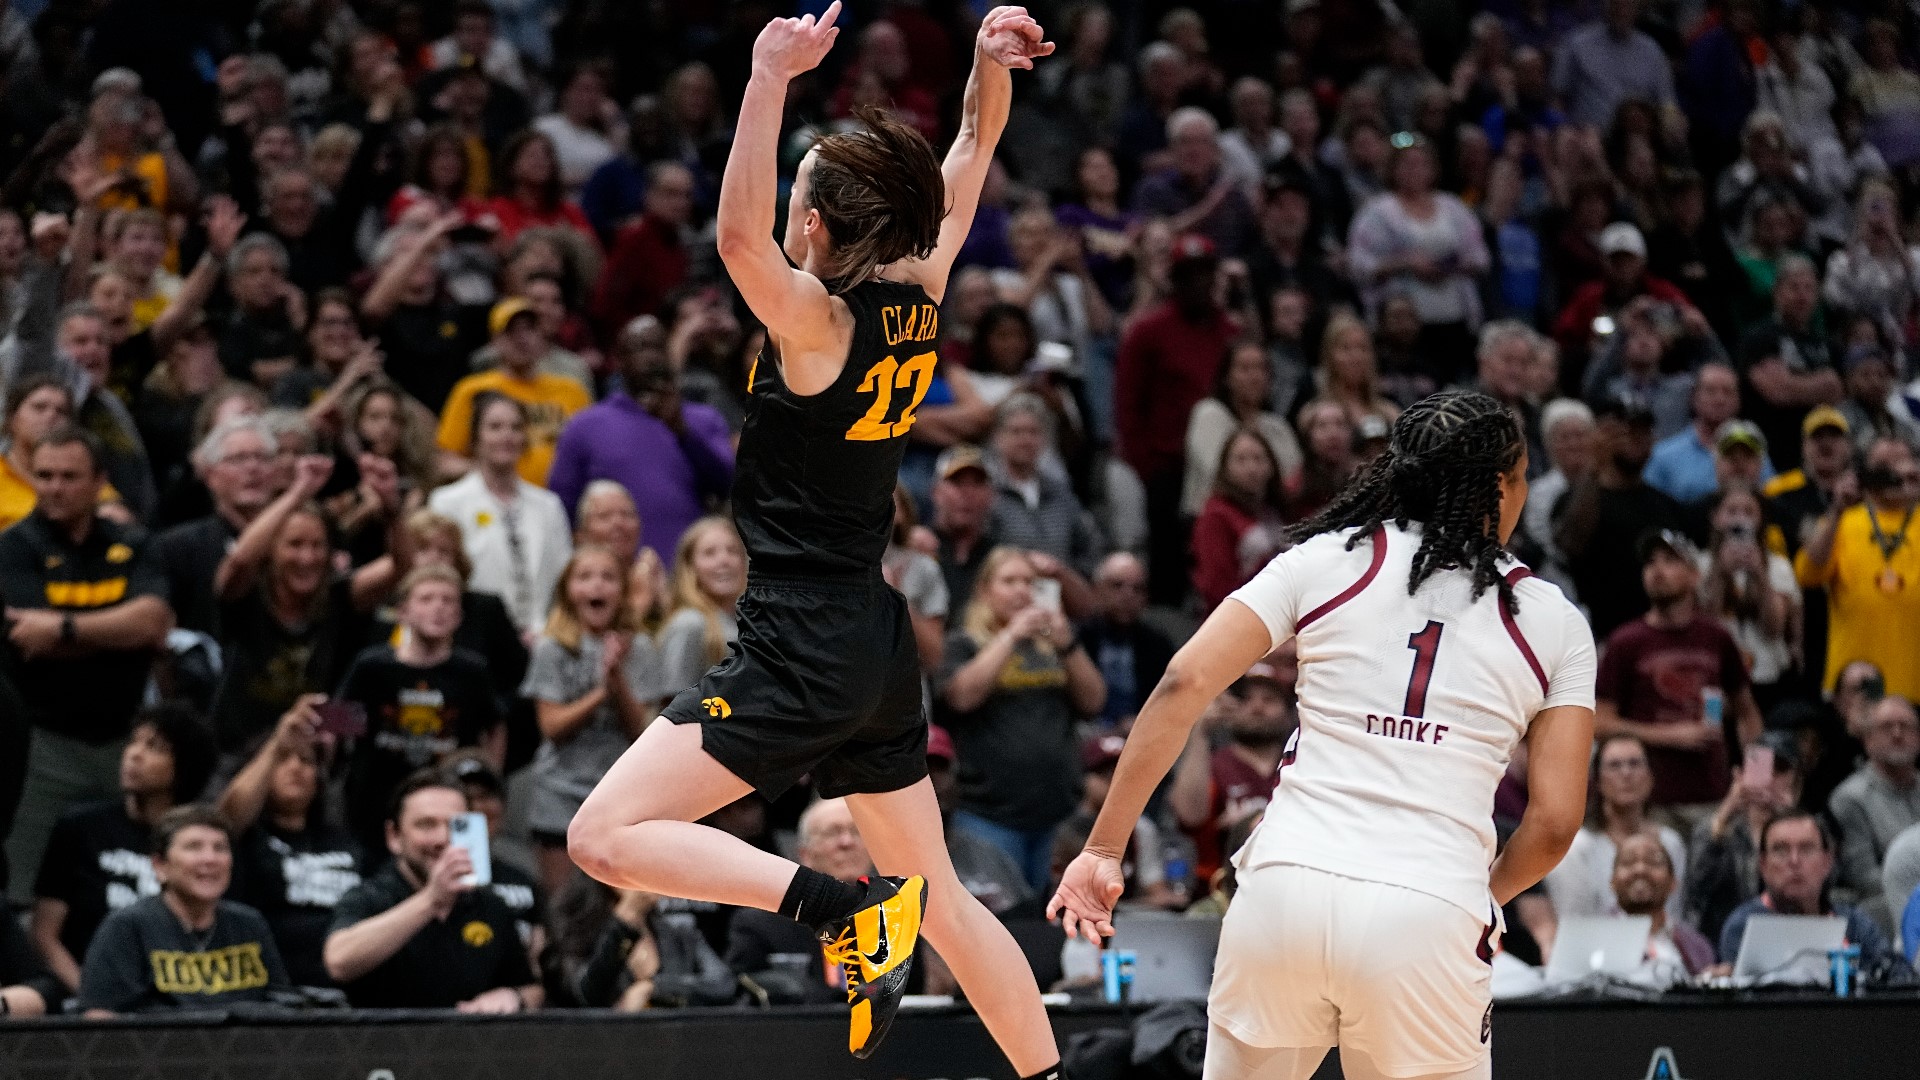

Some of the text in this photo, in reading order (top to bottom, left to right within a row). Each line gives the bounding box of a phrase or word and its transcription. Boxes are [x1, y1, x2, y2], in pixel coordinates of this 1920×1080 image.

[845, 351, 938, 441] 22
[1402, 619, 1445, 719] 1
[150, 942, 269, 994] IOWA
